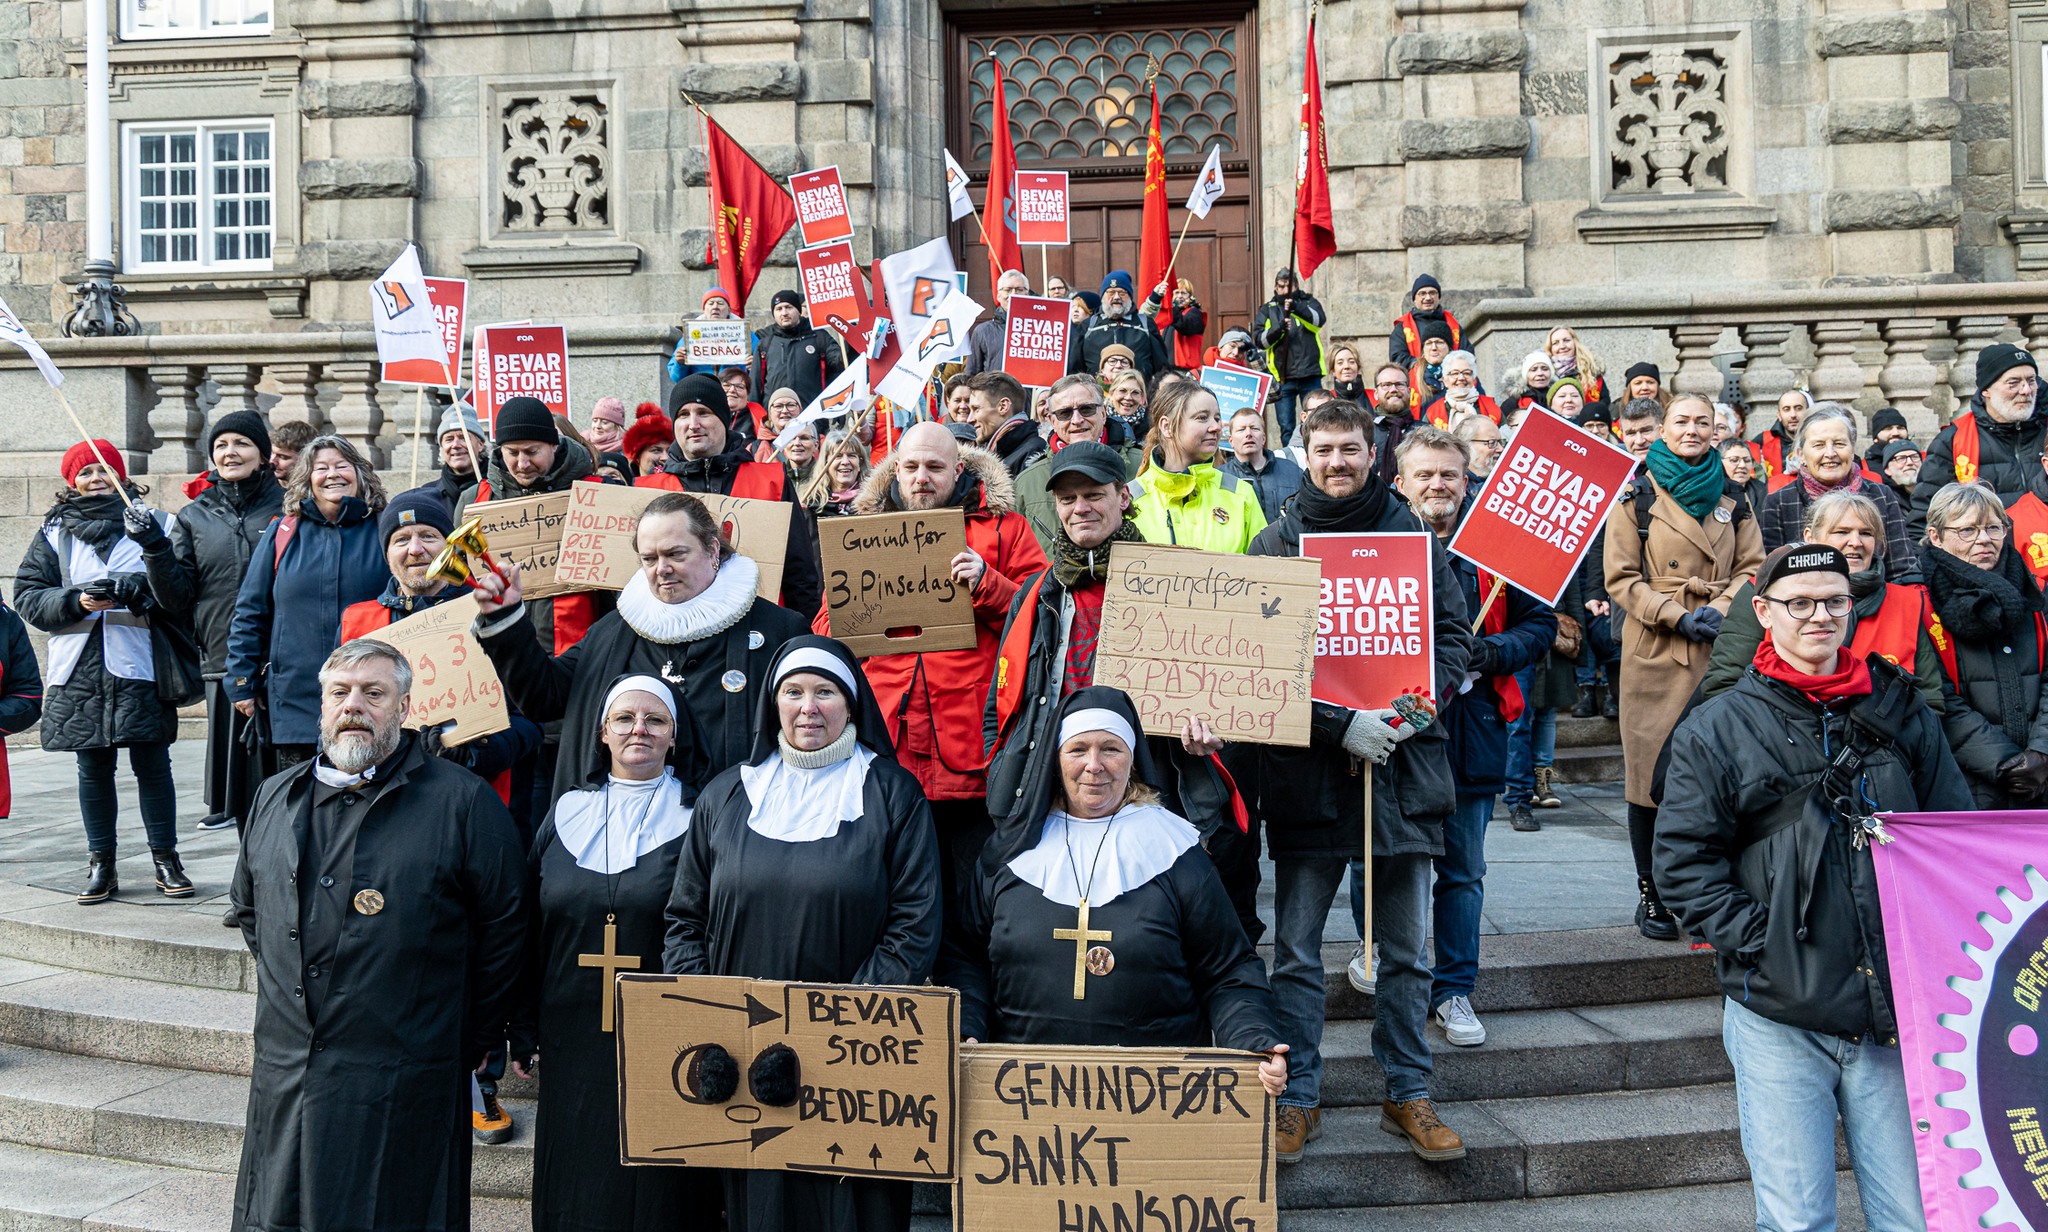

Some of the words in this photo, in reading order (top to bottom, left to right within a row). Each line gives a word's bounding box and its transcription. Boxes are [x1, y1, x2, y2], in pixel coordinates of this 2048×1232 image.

[797, 184, 840, 204] BEVAR
[1021, 189, 1064, 202] BEVAR
[800, 195, 843, 215] STORE
[802, 206, 845, 224] BEDEDAG
[1021, 201, 1064, 213] STORE
[1021, 212, 1065, 222] BEDEDAG
[805, 261, 851, 282] BEVAR
[808, 273, 852, 295] STORE
[809, 287, 855, 304] BEDEDAG
[829, 316, 849, 334] FOA
[1012, 317, 1064, 336] BEVAR
[693, 345, 741, 356] BEDRAG
[1010, 332, 1064, 350] STORE
[494, 352, 561, 373] BEVAR
[1009, 346, 1062, 362] BEDEDAG
[495, 371, 563, 391] STORE
[1564, 439, 1588, 457] FOA
[1509, 445, 1606, 513] BEVAR
[575, 487, 599, 507] VI
[1496, 470, 1593, 537] STORE
[569, 510, 637, 532] HOLDER
[1484, 493, 1579, 554] BEDEDAG
[564, 533, 606, 550] ØJE
[561, 551, 605, 566] MED
[1352, 549, 1378, 558] FOA
[1788, 552, 1834, 569] CHROME
[558, 567, 610, 583] JER!
[1320, 577, 1420, 605] BEVAR
[1317, 606, 1421, 634] STORE
[448, 633, 467, 667] 3
[1314, 635, 1421, 656] BEDEDAG
[806, 991, 923, 1035] BEVAR
[826, 1035, 924, 1065] STORE
[994, 1059, 1250, 1120] GENINDFØR
[800, 1085, 938, 1142] BEDEDAG
[973, 1125, 1130, 1187] SANKT
[1058, 1190, 1256, 1232] HANSDAG
